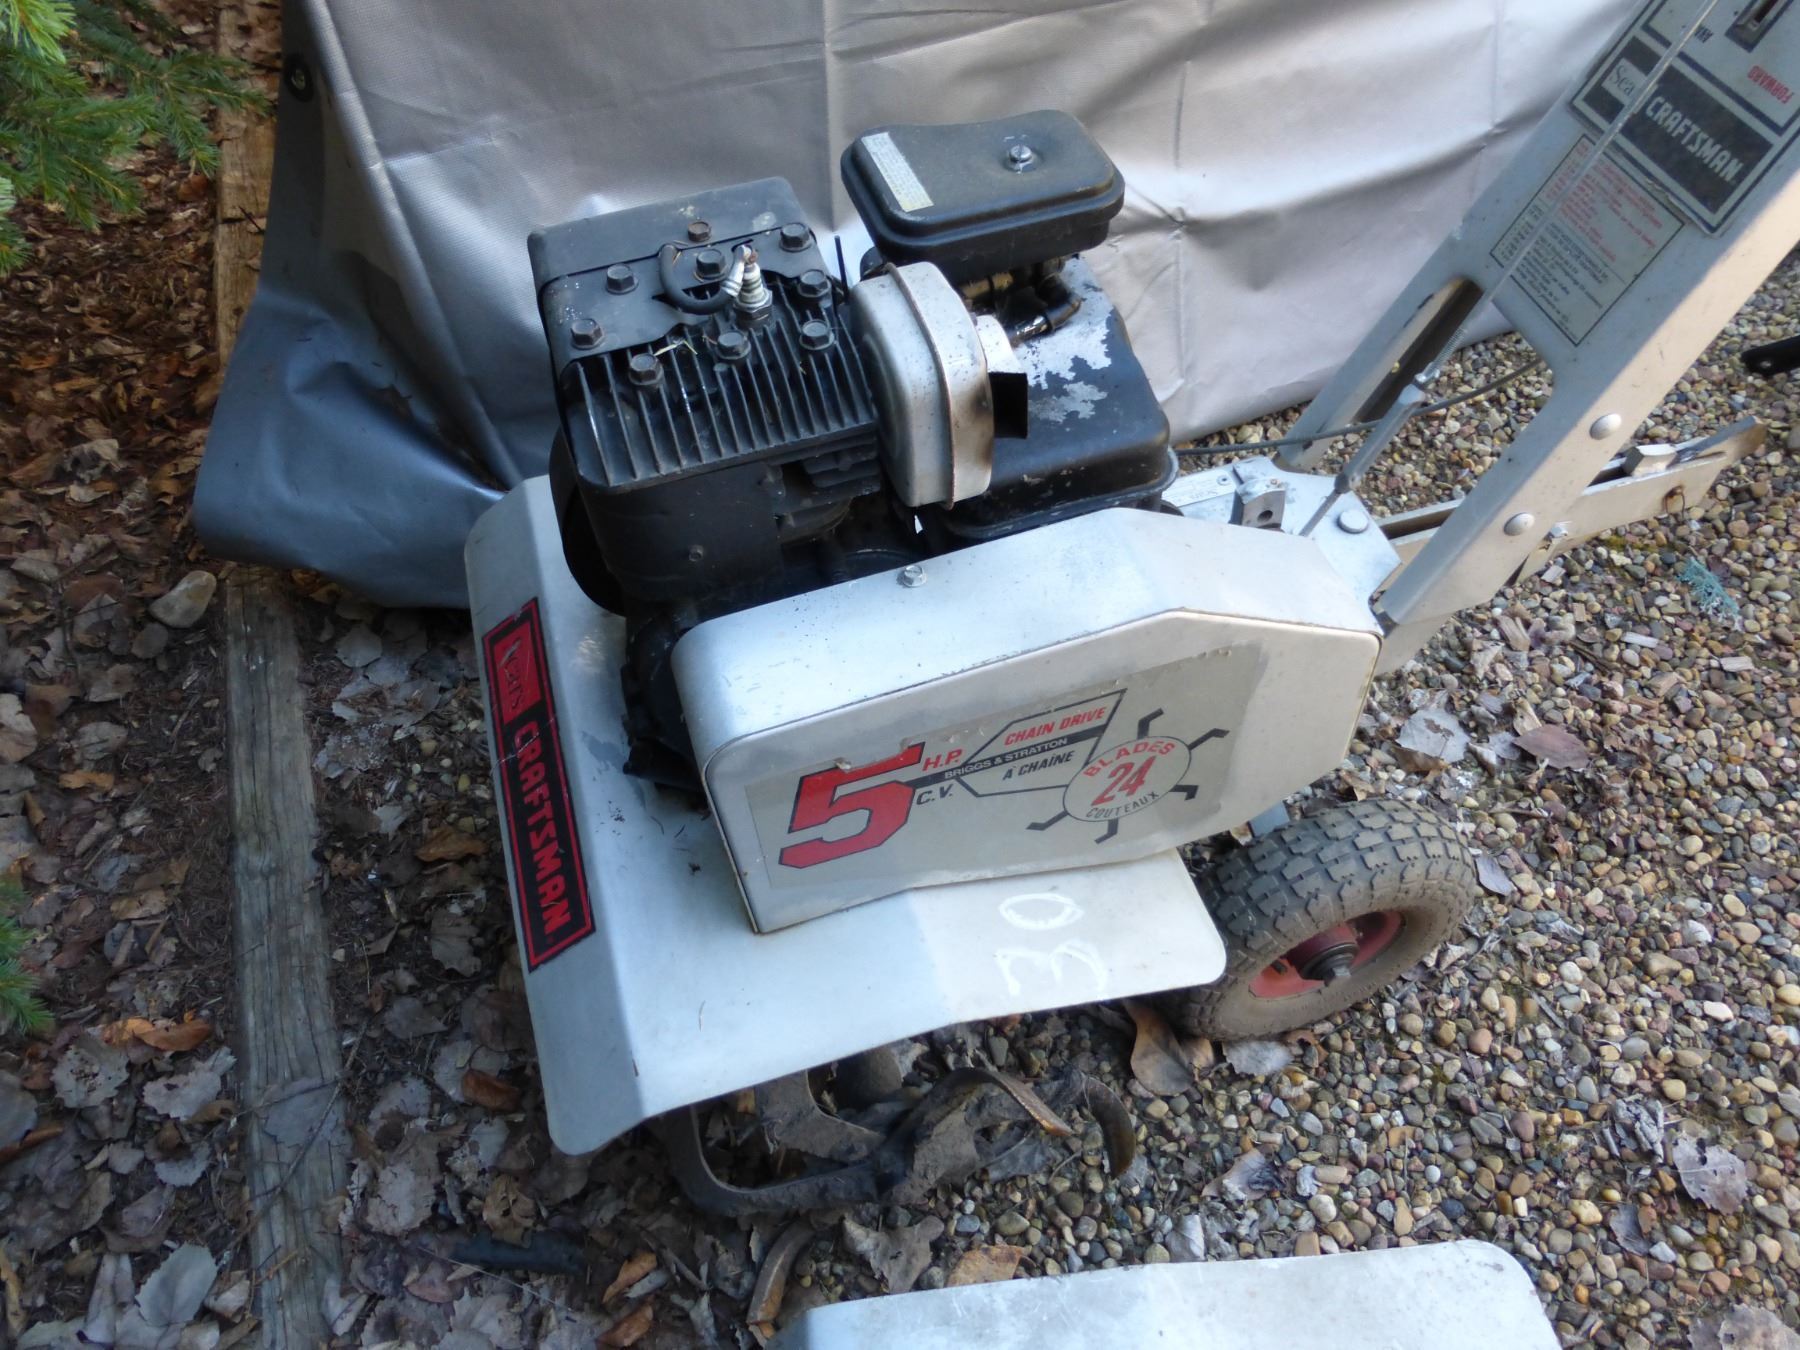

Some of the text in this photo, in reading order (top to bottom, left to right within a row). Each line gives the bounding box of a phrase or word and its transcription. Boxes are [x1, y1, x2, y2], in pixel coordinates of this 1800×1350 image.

[1747, 65, 1793, 104] FORWARD
[1645, 96, 1744, 182] CRAFTSMAN
[1004, 707, 1107, 746] CHAIN DRIVE
[944, 737, 1068, 779] BRIGGS & STRATTON
[1083, 740, 1176, 777] BLADES
[916, 783, 954, 805] C.V.
[1091, 755, 1157, 806] 24
[778, 741, 963, 870] 5 H.P.
[1086, 791, 1159, 819] COUTEAUX
[514, 720, 571, 935] CRAFTSMAN
